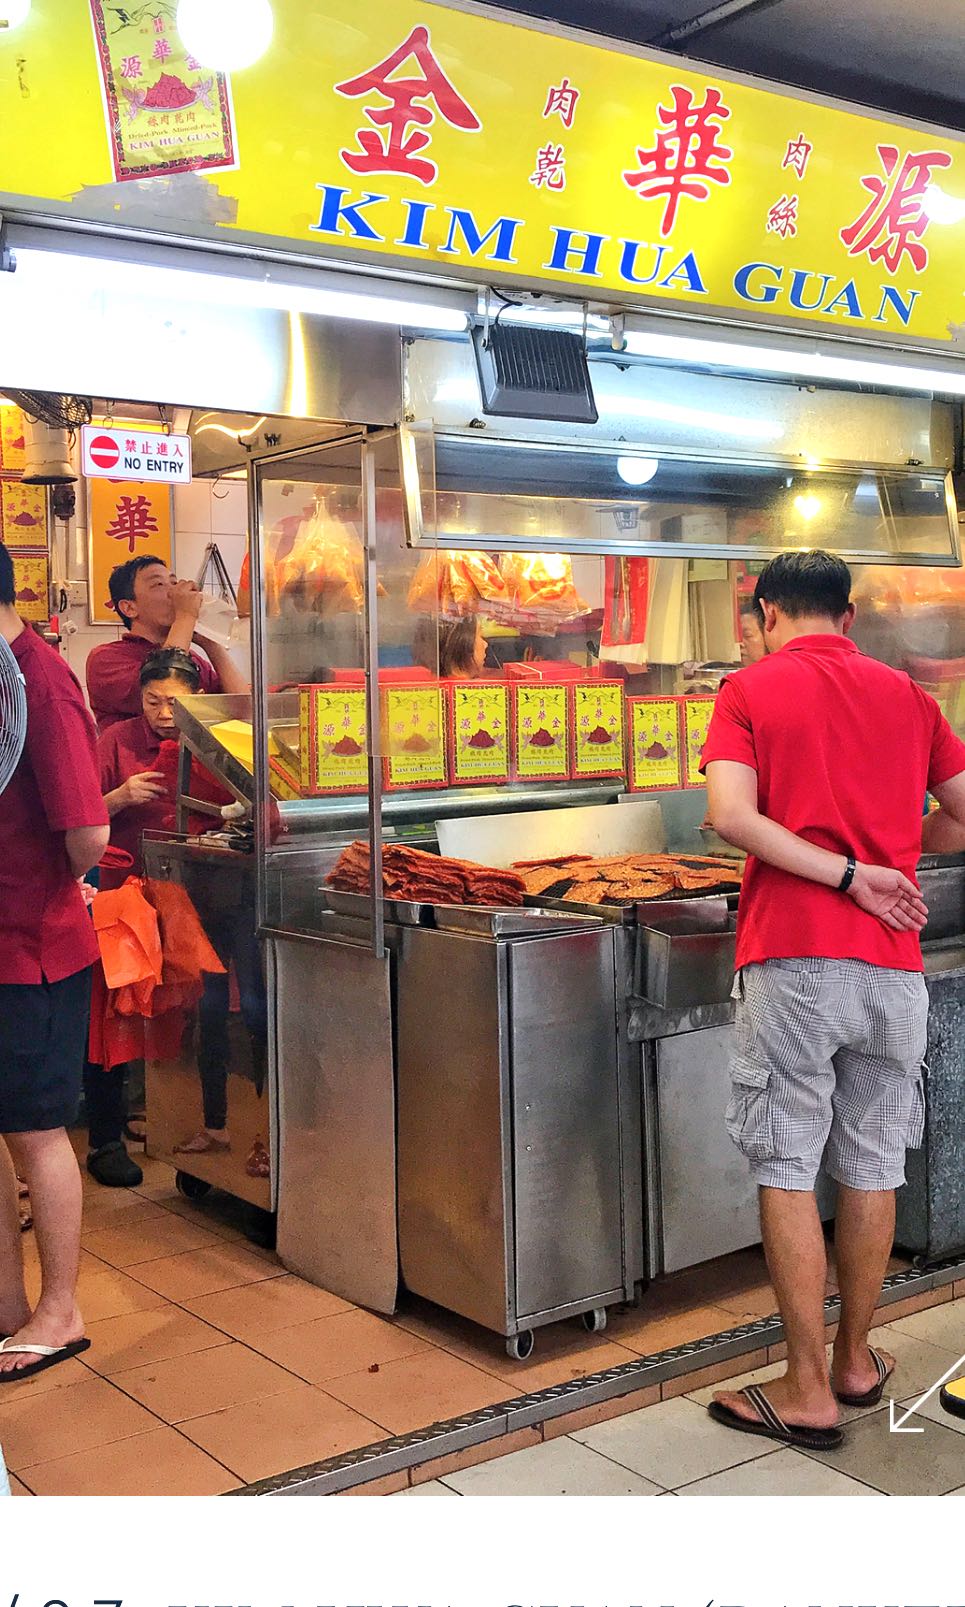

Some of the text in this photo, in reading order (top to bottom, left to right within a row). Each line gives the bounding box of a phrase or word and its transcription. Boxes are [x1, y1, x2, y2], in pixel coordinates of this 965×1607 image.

[130, 131, 220, 150] KIM HUA GUAN
[336, 26, 952, 273] 金 華 源
[531, 79, 579, 191] 肉乾
[311, 185, 920, 326] KIM HUA GUAN
[124, 457, 184, 473] NO ENTRY
[125, 439, 184, 457] 禁止進入
[105, 496, 159, 553] 華
